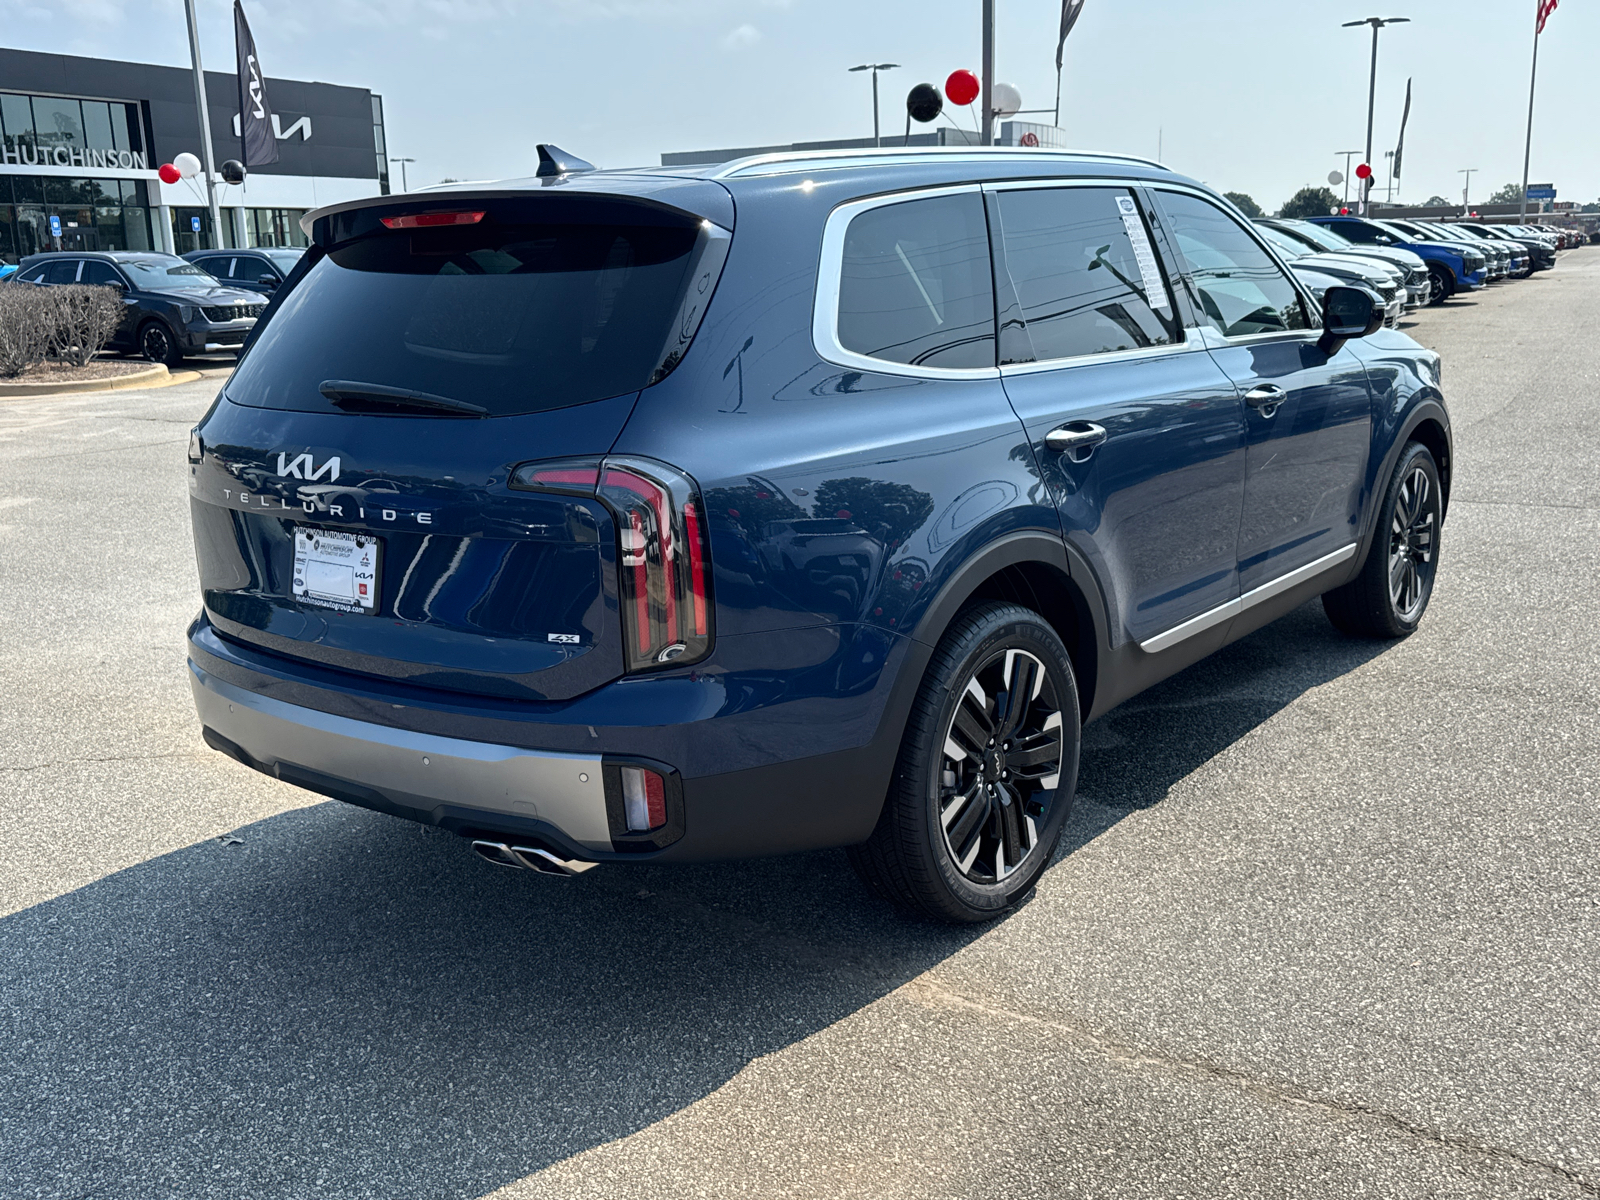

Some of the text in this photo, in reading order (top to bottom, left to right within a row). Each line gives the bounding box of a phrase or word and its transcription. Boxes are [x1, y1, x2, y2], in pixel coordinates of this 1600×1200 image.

[247, 54, 265, 119] KIA
[2, 144, 148, 170] HUTCHINSON
[277, 452, 341, 483] KIA
[224, 489, 432, 524] TELLURIDE
[355, 572, 373, 580] KIA
